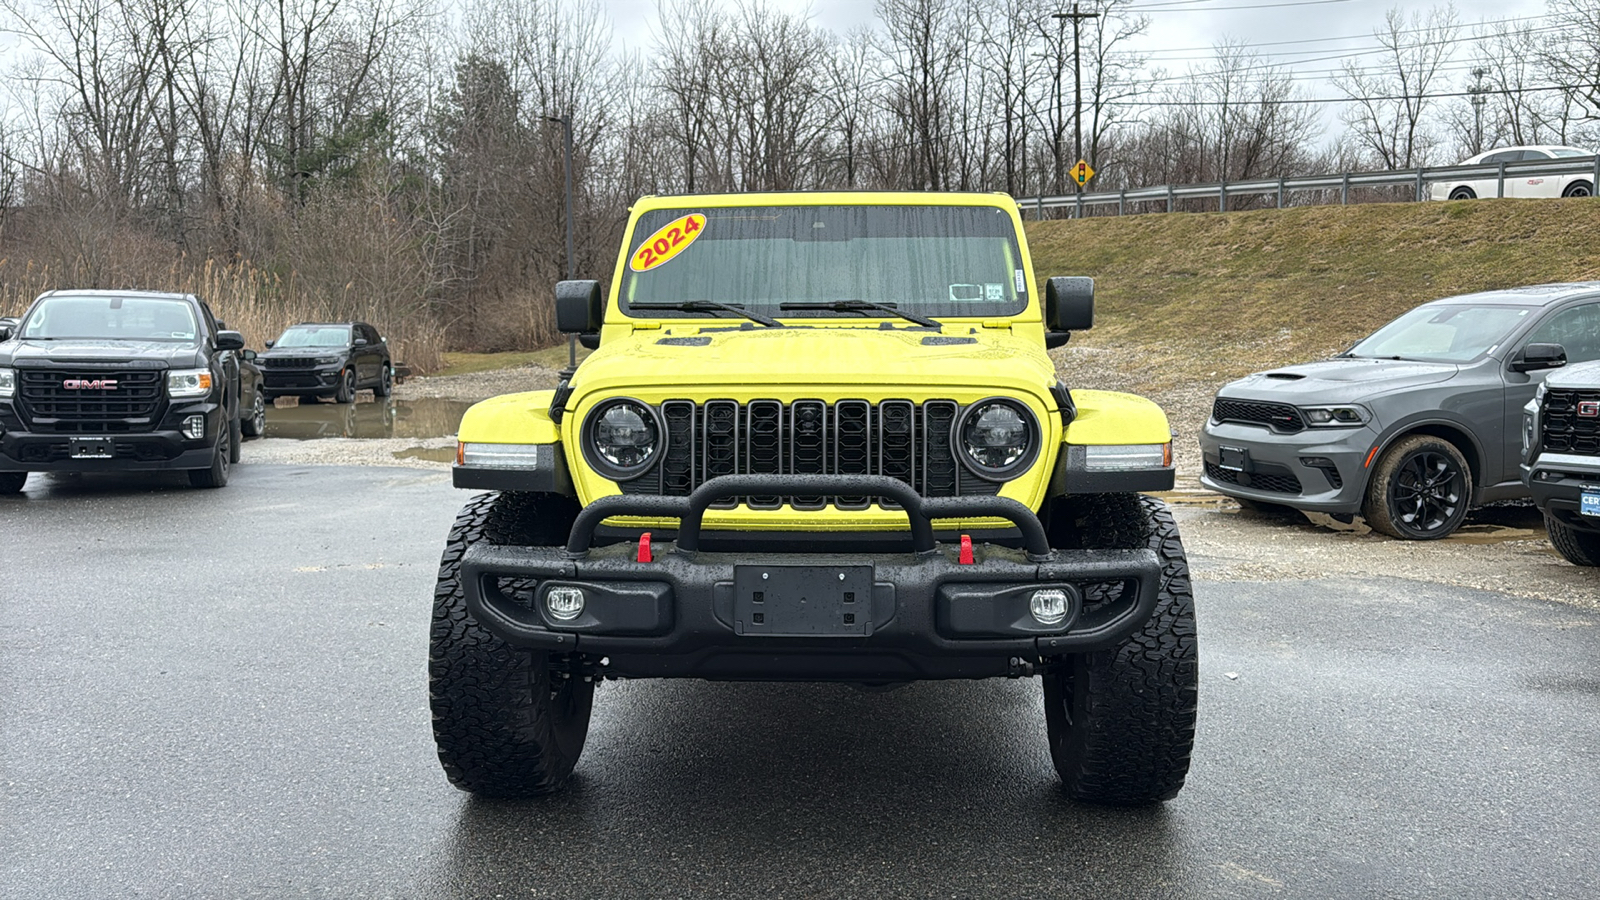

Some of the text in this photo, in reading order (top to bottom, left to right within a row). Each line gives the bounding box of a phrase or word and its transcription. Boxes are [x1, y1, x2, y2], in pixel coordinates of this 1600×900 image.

[638, 216, 700, 268] 2024
[63, 379, 118, 390] GMC
[1582, 496, 1600, 506] CER
